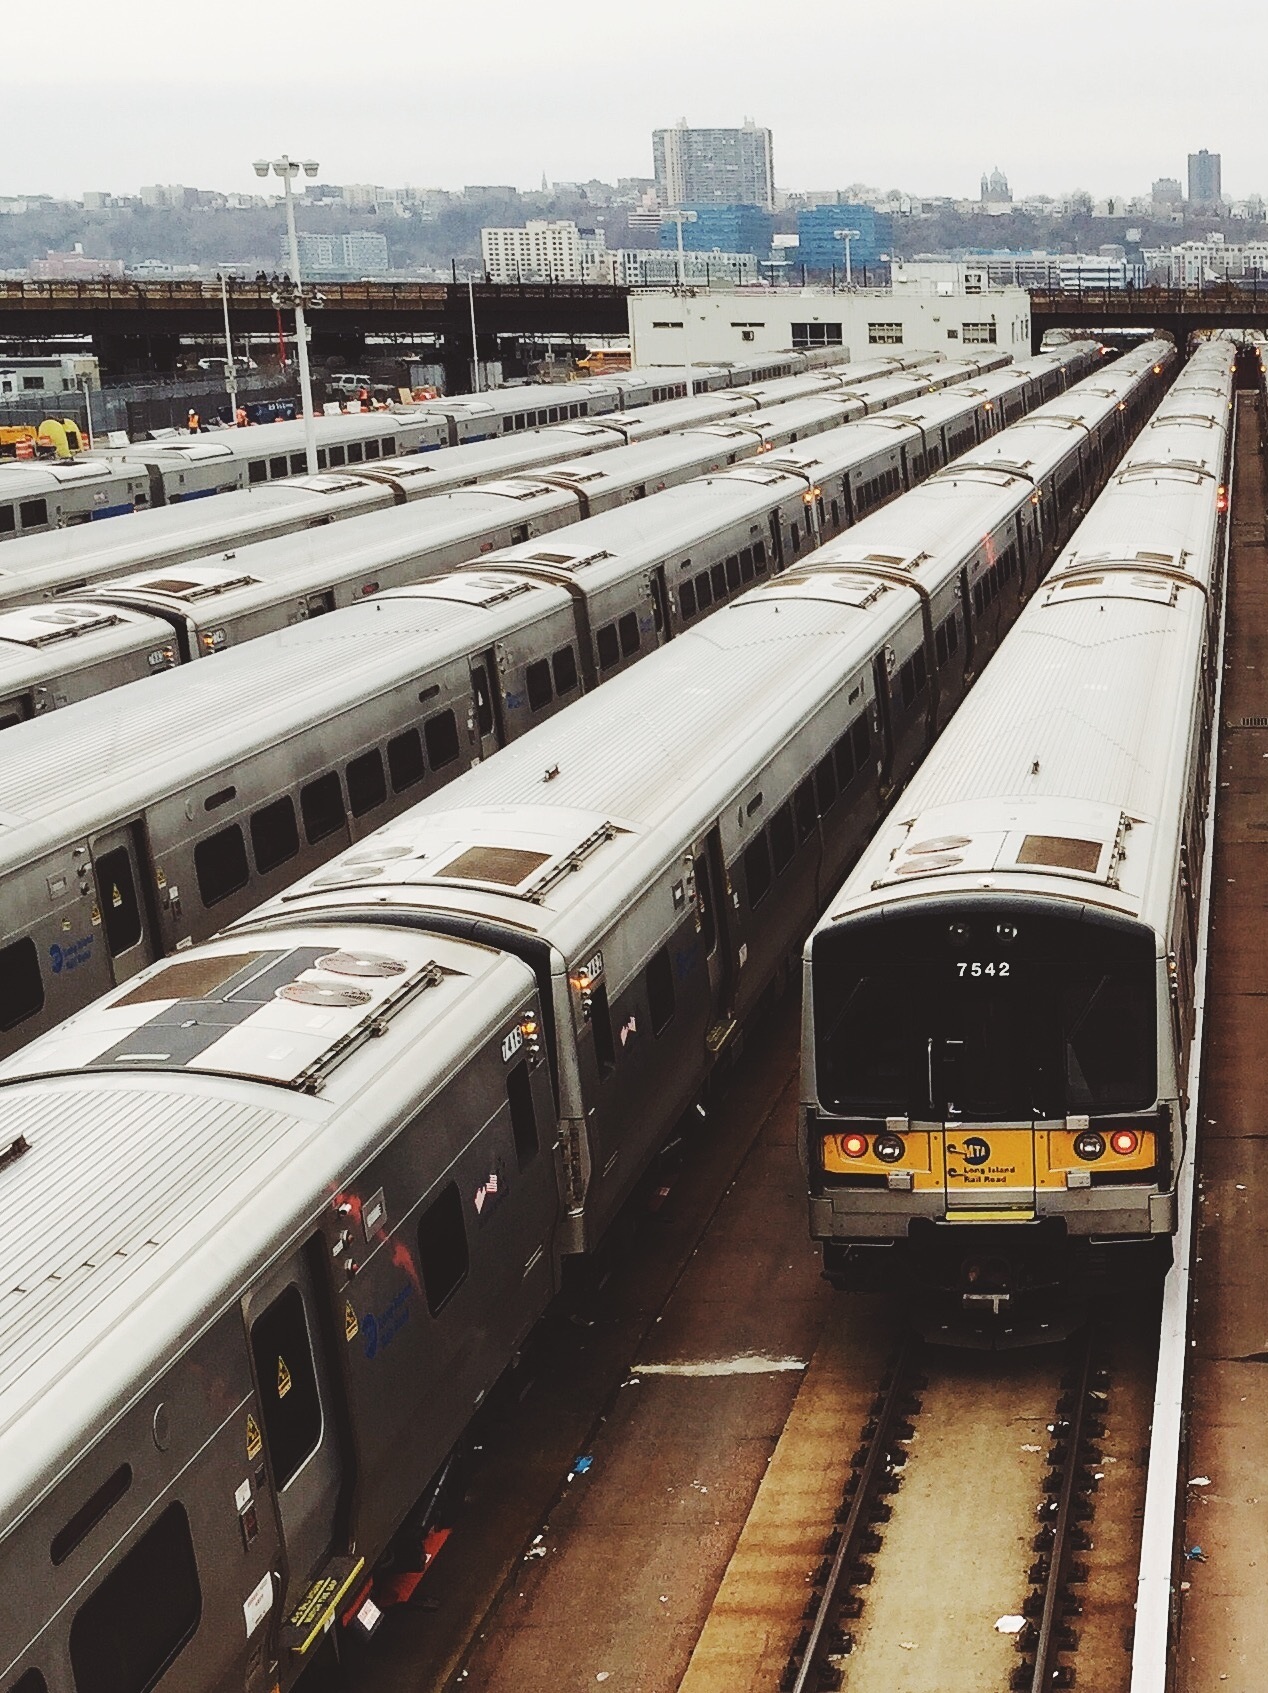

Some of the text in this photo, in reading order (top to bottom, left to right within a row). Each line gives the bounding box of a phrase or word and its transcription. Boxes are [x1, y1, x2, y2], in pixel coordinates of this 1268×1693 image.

[956, 961, 1010, 977] 7542
[963, 1166, 1016, 1175] Long Island
